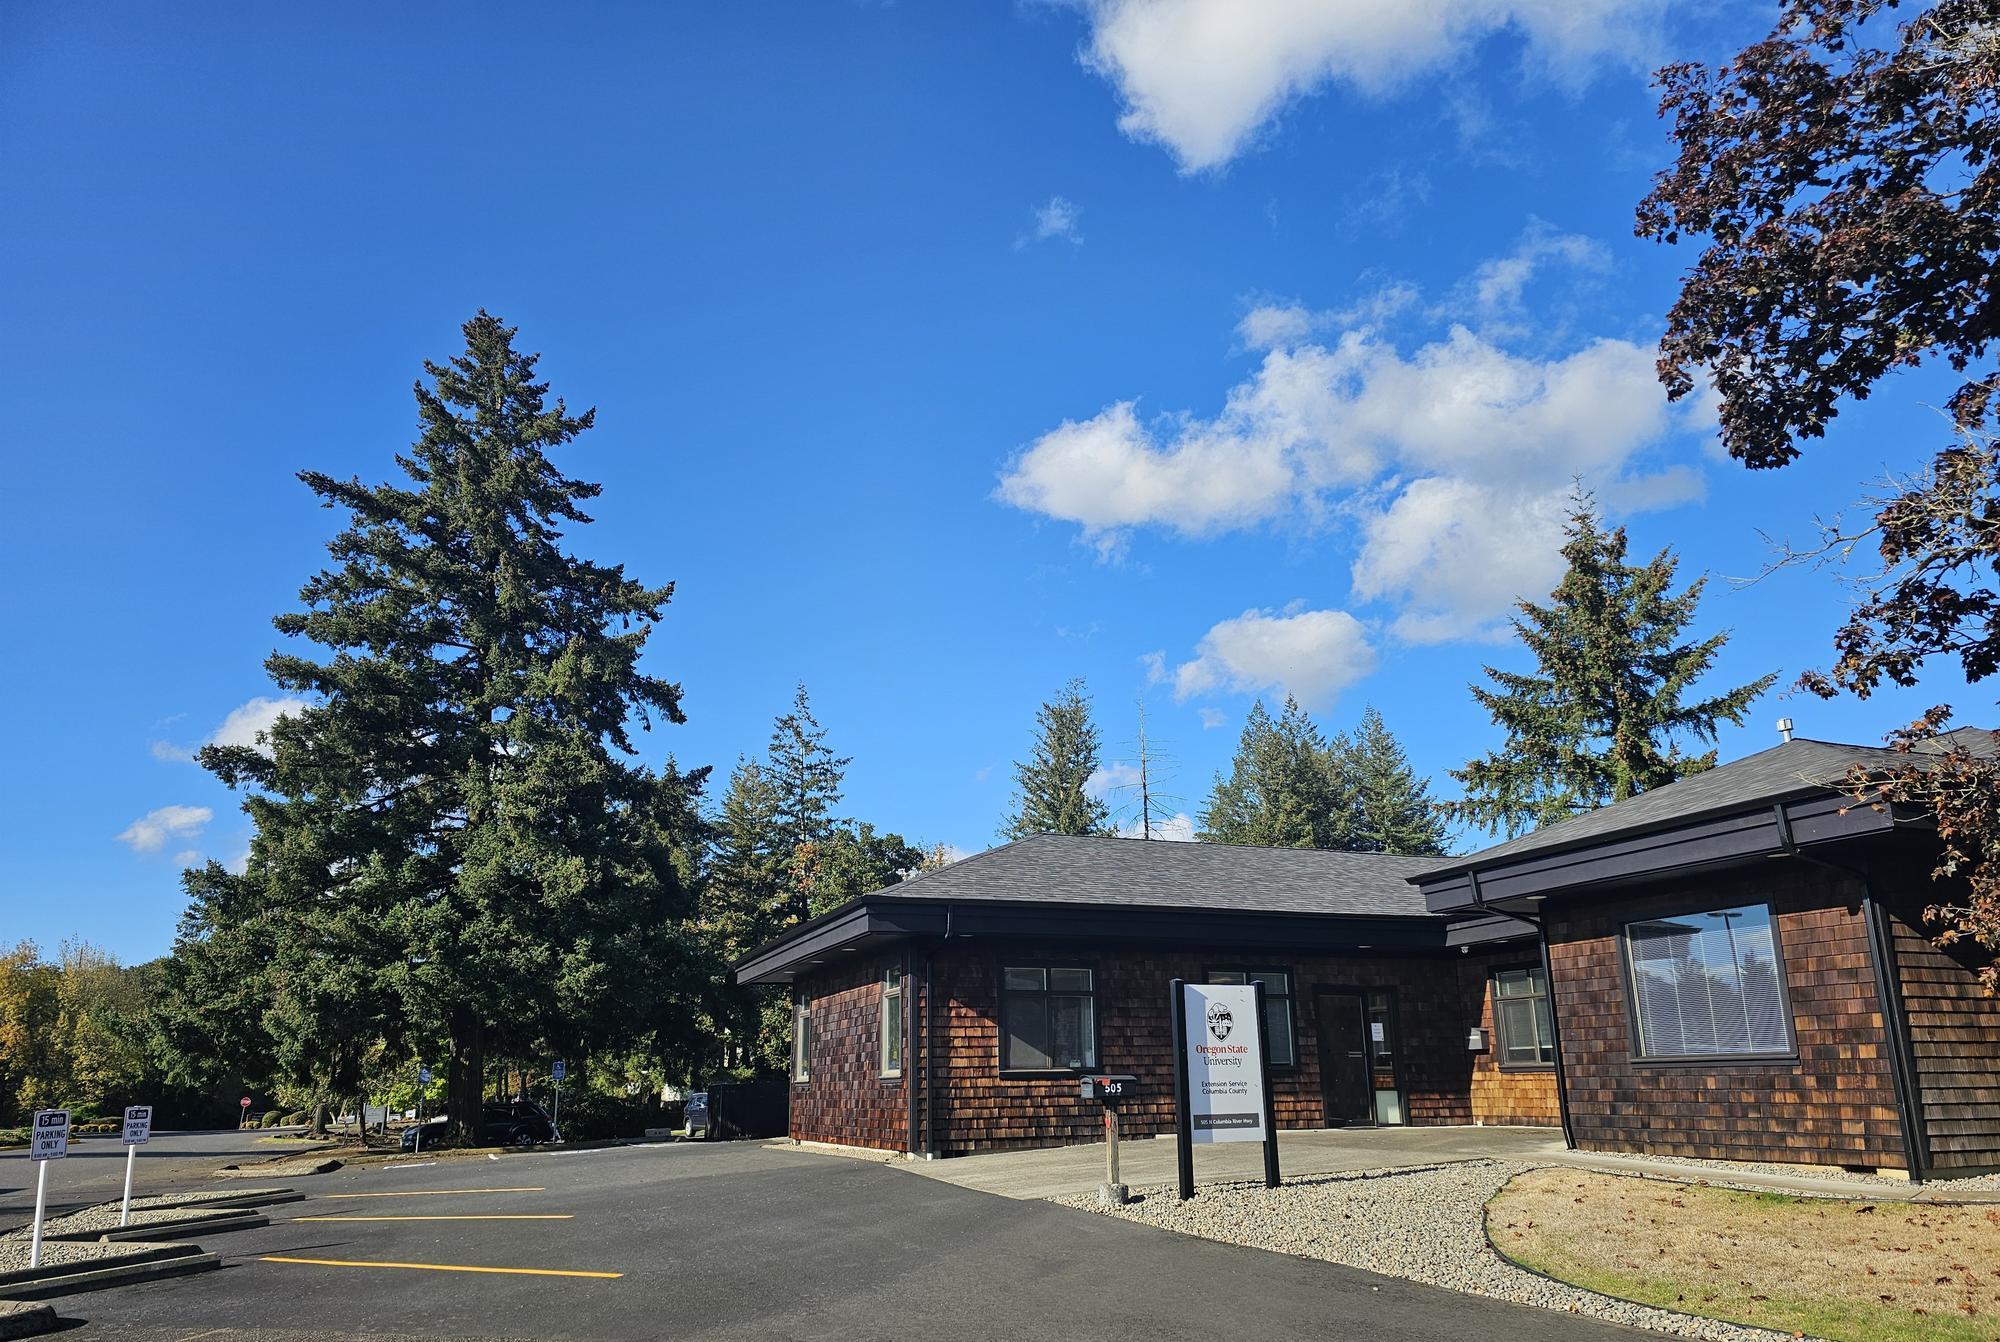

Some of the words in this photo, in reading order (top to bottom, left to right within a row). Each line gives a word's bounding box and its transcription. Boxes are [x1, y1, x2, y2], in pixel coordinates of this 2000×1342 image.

[1196, 1044, 1227, 1056] Oregon
[1227, 1044, 1248, 1054] State
[1203, 1056, 1242, 1068] University
[1105, 1083, 1122, 1093] 505
[1228, 1088, 1248, 1096] County
[130, 1110, 137, 1119] 15
[41, 1115, 50, 1125] 15
[51, 1115, 64, 1125] min
[126, 1121, 148, 1129] PARKING
[36, 1129, 66, 1140] PARKING
[130, 1129, 143, 1137] ONLY
[41, 1139, 59, 1150] ONLY
